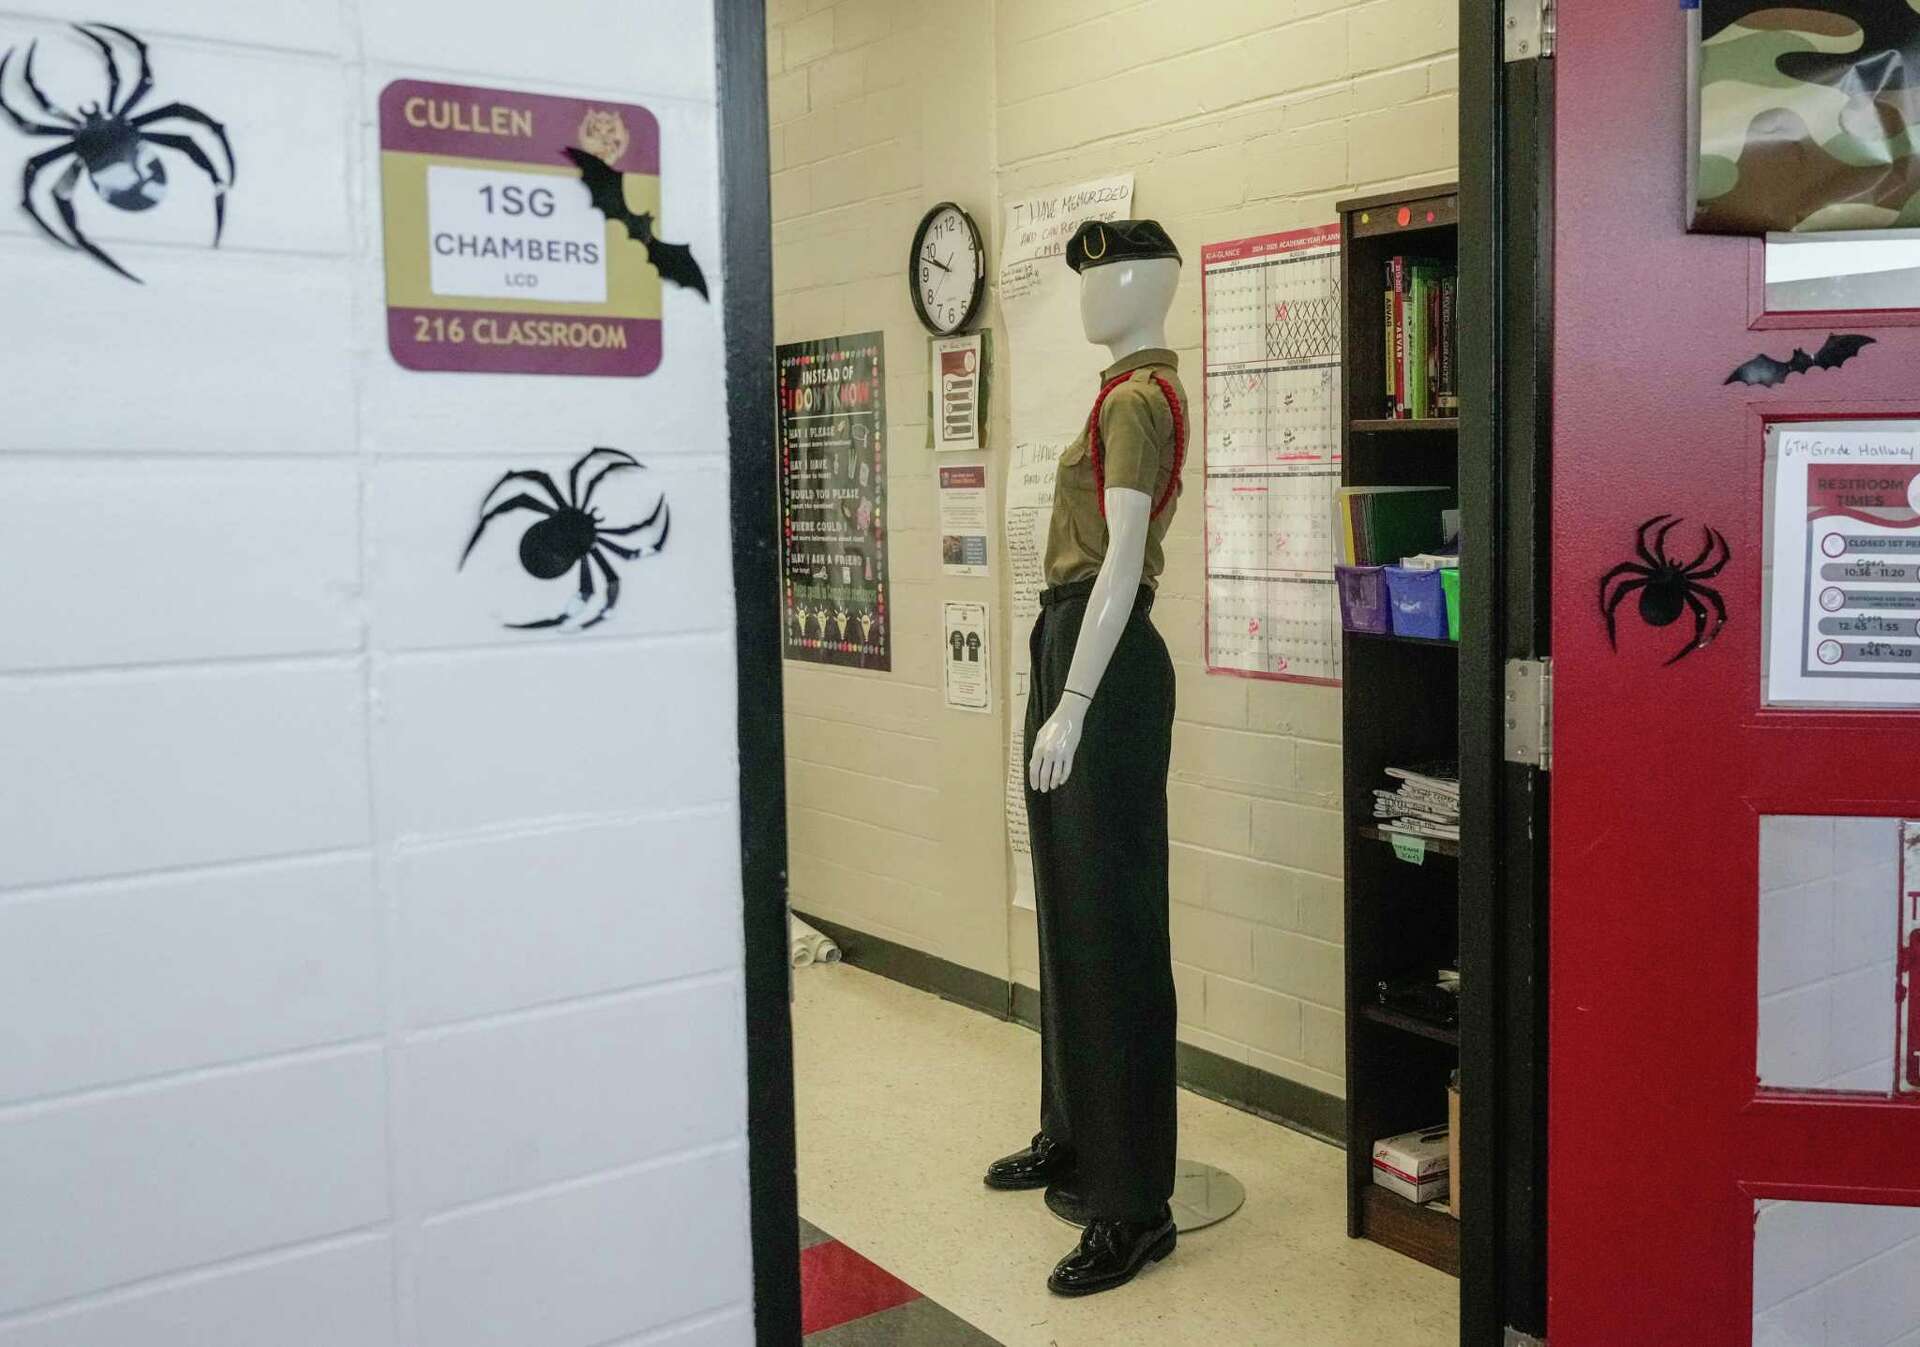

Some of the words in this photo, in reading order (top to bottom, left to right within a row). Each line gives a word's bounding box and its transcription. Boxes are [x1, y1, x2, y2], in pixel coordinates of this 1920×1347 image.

[404, 97, 533, 138] CULLEN
[478, 184, 556, 218] 1SG
[934, 223, 944, 240] 11
[944, 215, 955, 232] 12
[1321, 230, 1340, 242] PLANN
[433, 232, 600, 266] CHAMBERS
[926, 242, 937, 259] 10
[504, 273, 539, 289] LCD
[922, 266, 930, 283] 9
[927, 288, 934, 305] 8
[936, 303, 943, 319] 7
[948, 307, 955, 324] 6
[414, 315, 466, 343] 216
[472, 319, 627, 350] CLASSROOM
[802, 368, 840, 385] INSTEAD
[842, 366, 854, 380] OF
[1858, 442, 1914, 461] Hallway
[1817, 479, 1905, 491] RESTROOM
[1836, 495, 1884, 507] TIMES
[1847, 539, 1886, 548] CLOSED
